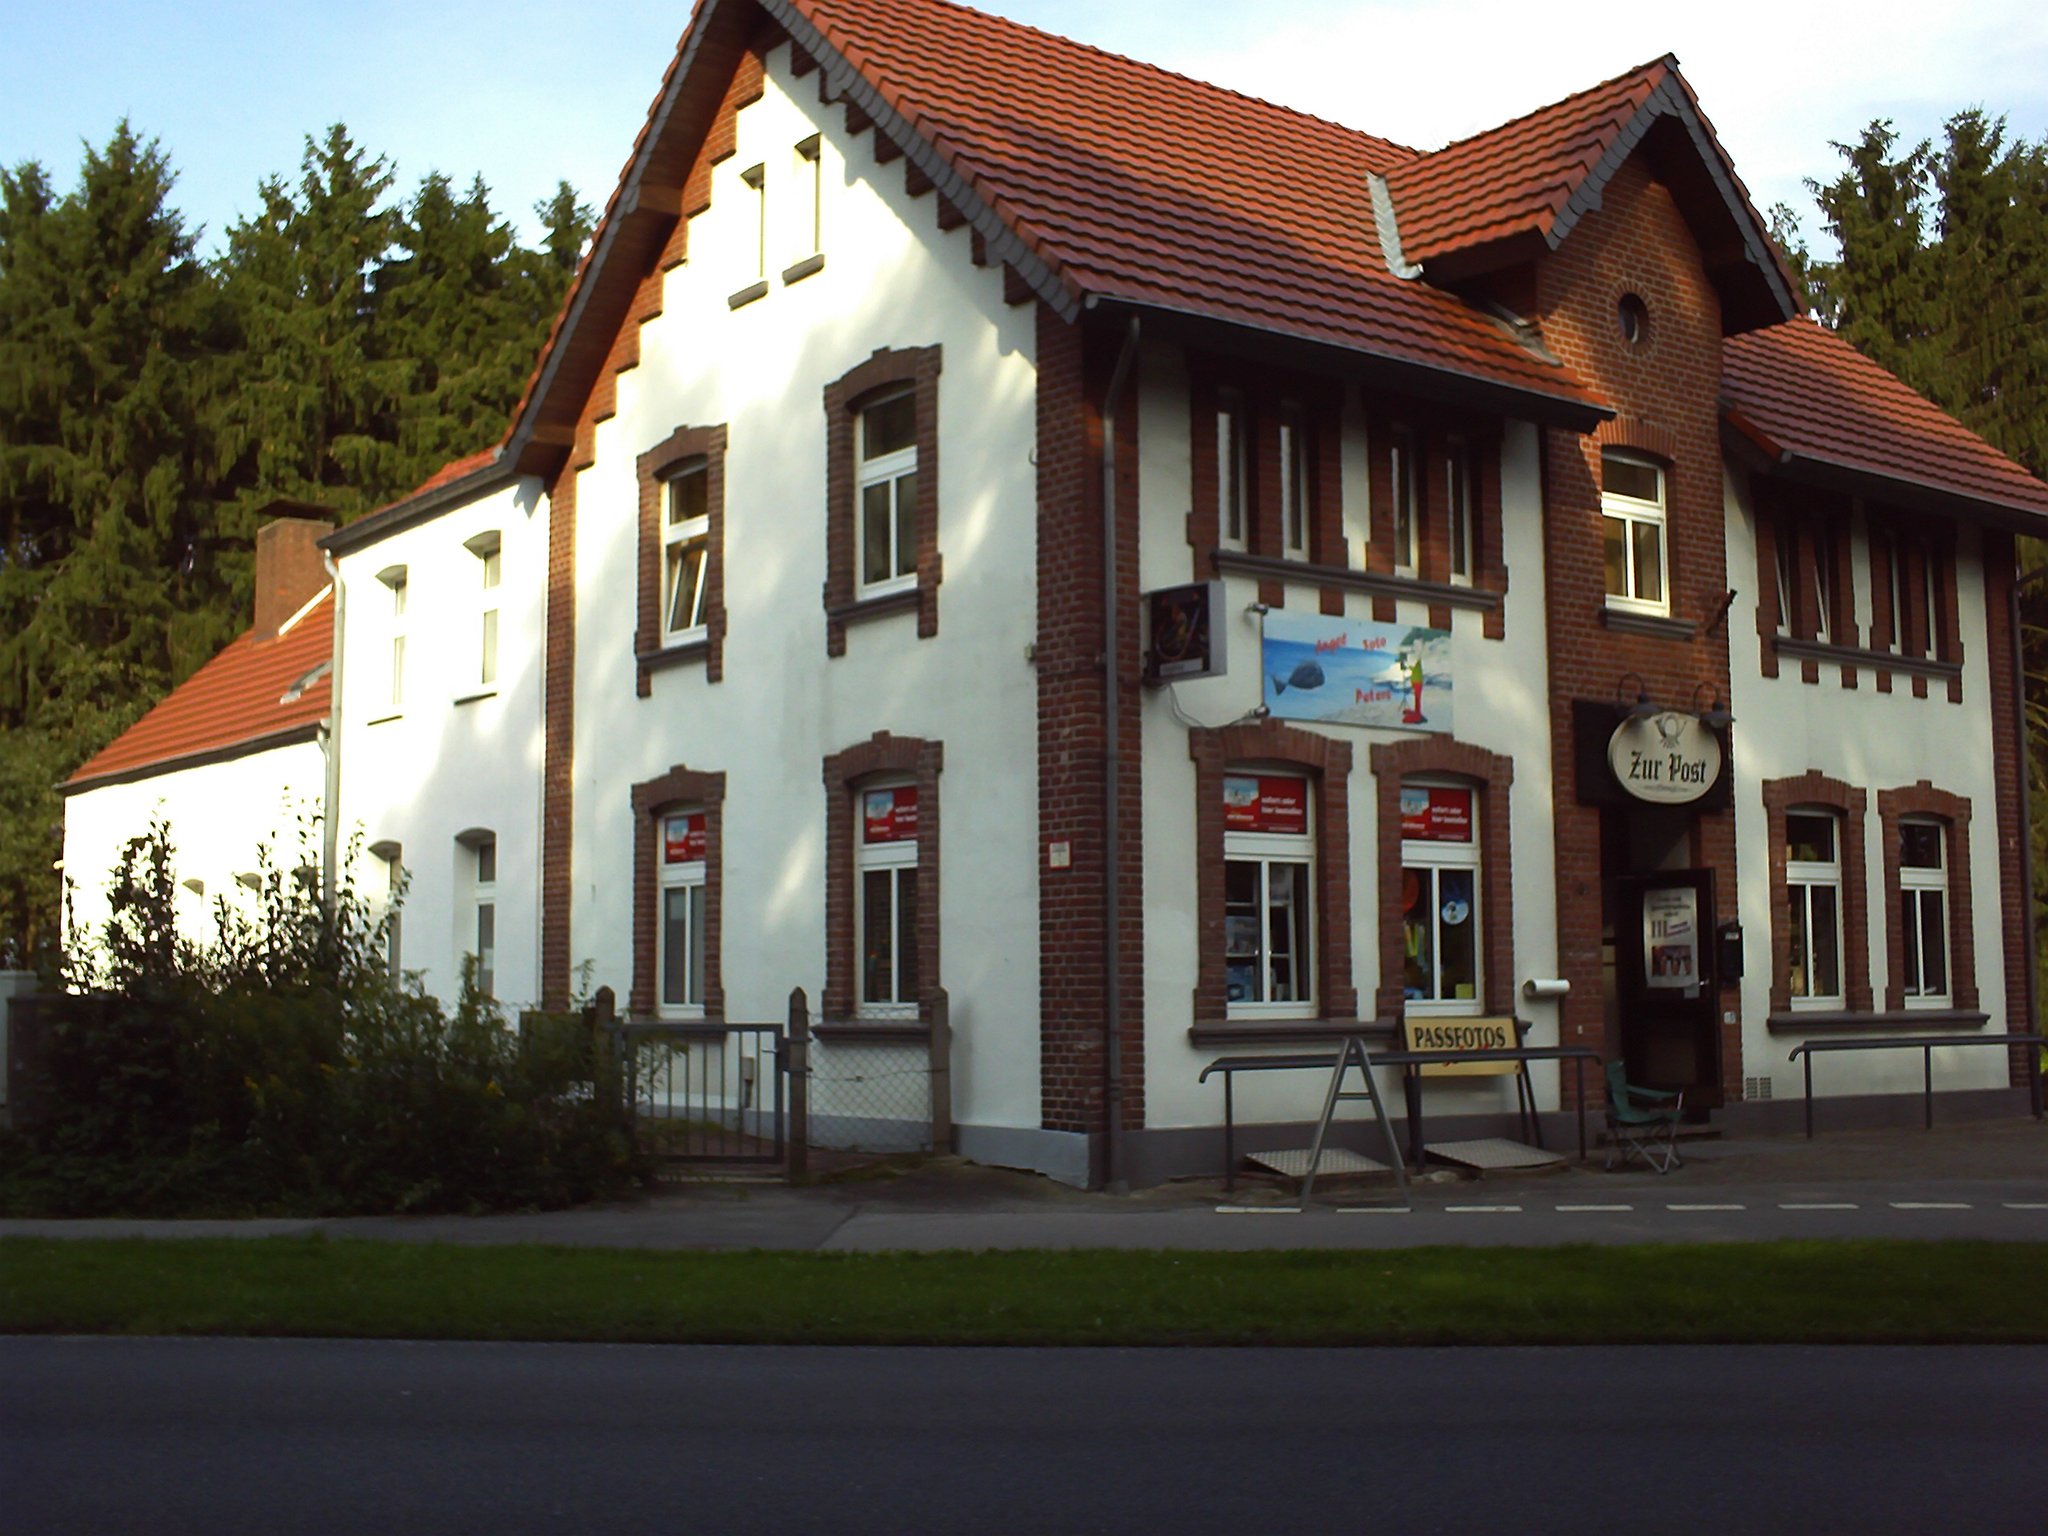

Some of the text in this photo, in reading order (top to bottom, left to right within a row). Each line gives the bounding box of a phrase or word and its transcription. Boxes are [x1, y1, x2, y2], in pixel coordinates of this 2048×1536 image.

[1628, 750, 1707, 783] Zur Post
[1414, 1026, 1506, 1049] PASSFOTOS
